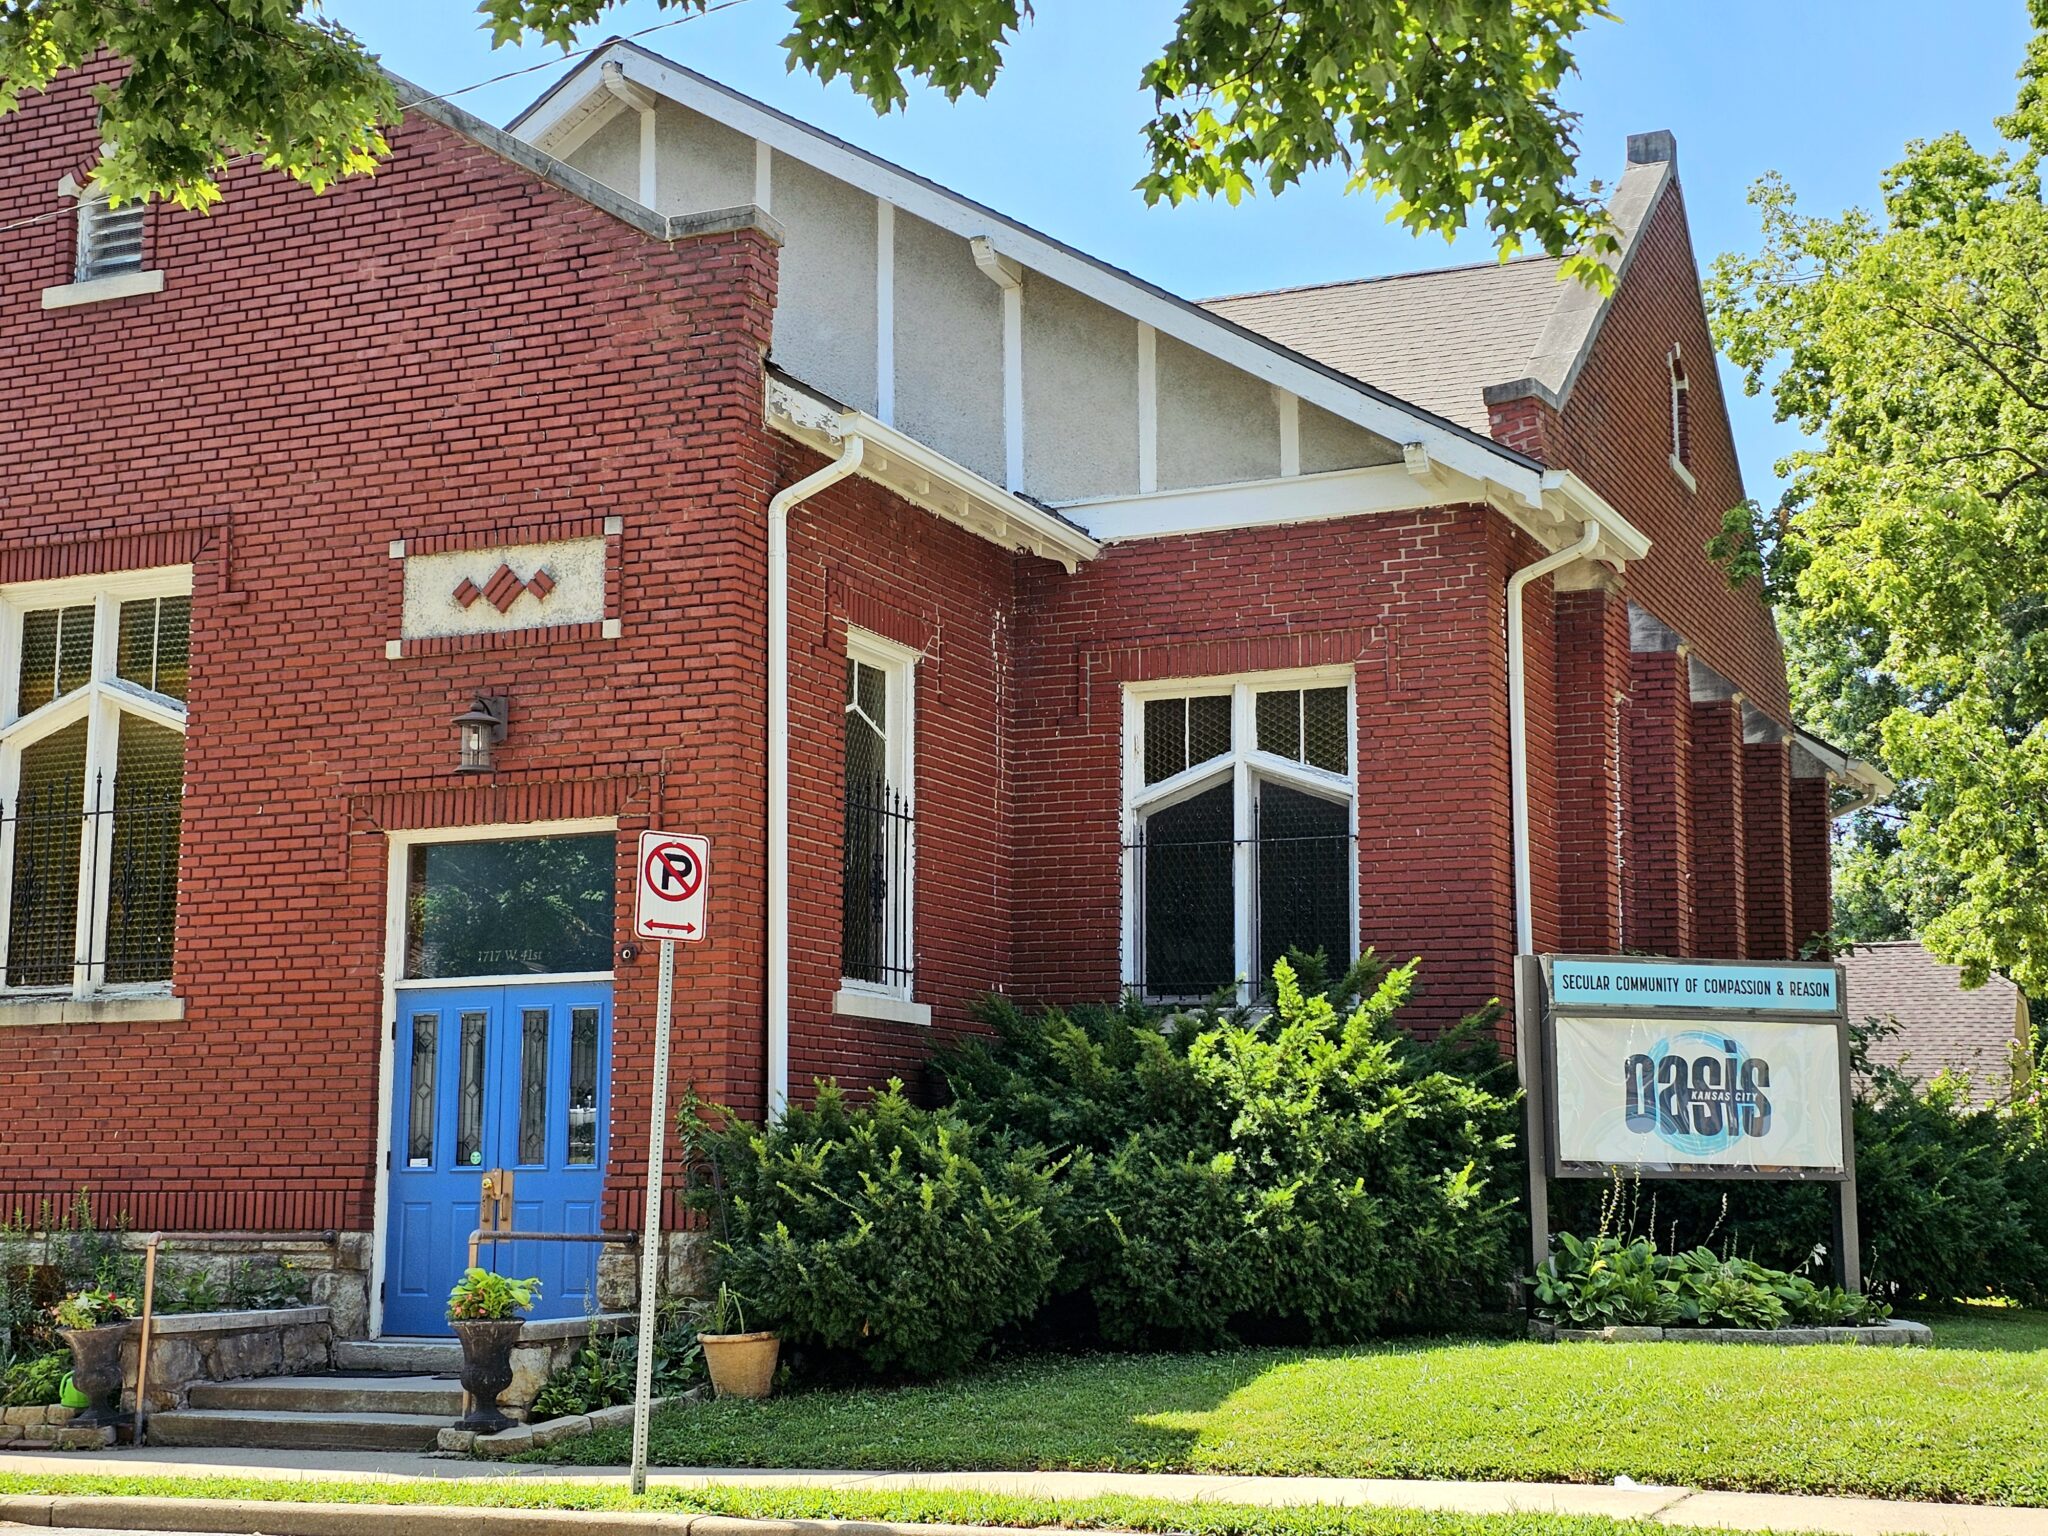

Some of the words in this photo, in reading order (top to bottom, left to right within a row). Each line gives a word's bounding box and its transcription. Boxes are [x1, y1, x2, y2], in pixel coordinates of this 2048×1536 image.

[661, 852, 693, 891] P
[478, 950, 502, 962] 1717
[505, 949, 518, 961] W.
[520, 949, 542, 961] 41st
[1562, 974, 1610, 991] SECULAR
[1616, 975, 1679, 992] COMMUNITY
[1685, 978, 1698, 993] OF
[1704, 978, 1771, 995] COMPASSION
[1777, 981, 1784, 996] &
[1790, 981, 1830, 997] REASON
[1691, 1090, 1731, 1101] KANSAS
[1735, 1092, 1758, 1102] CITY
